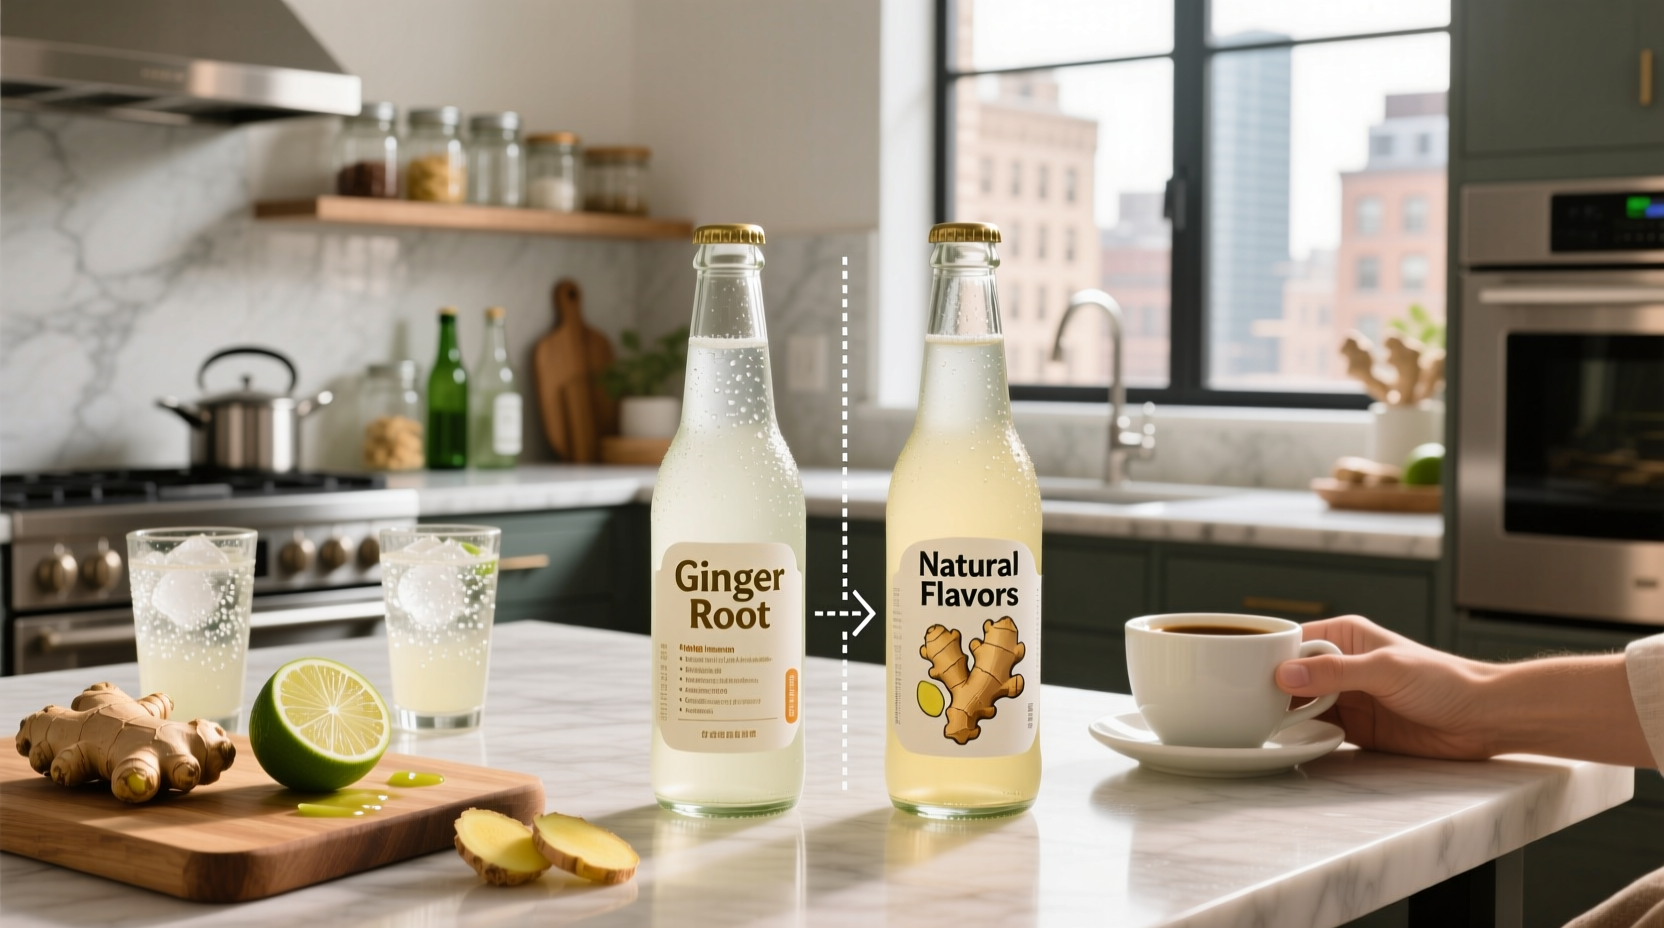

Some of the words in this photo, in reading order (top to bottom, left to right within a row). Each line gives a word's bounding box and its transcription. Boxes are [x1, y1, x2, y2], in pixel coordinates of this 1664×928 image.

[919, 550, 1019, 577] Natural
[675, 559, 785, 602] Ginger
[921, 581, 1019, 607] Flavors
[690, 598, 771, 630] Root
